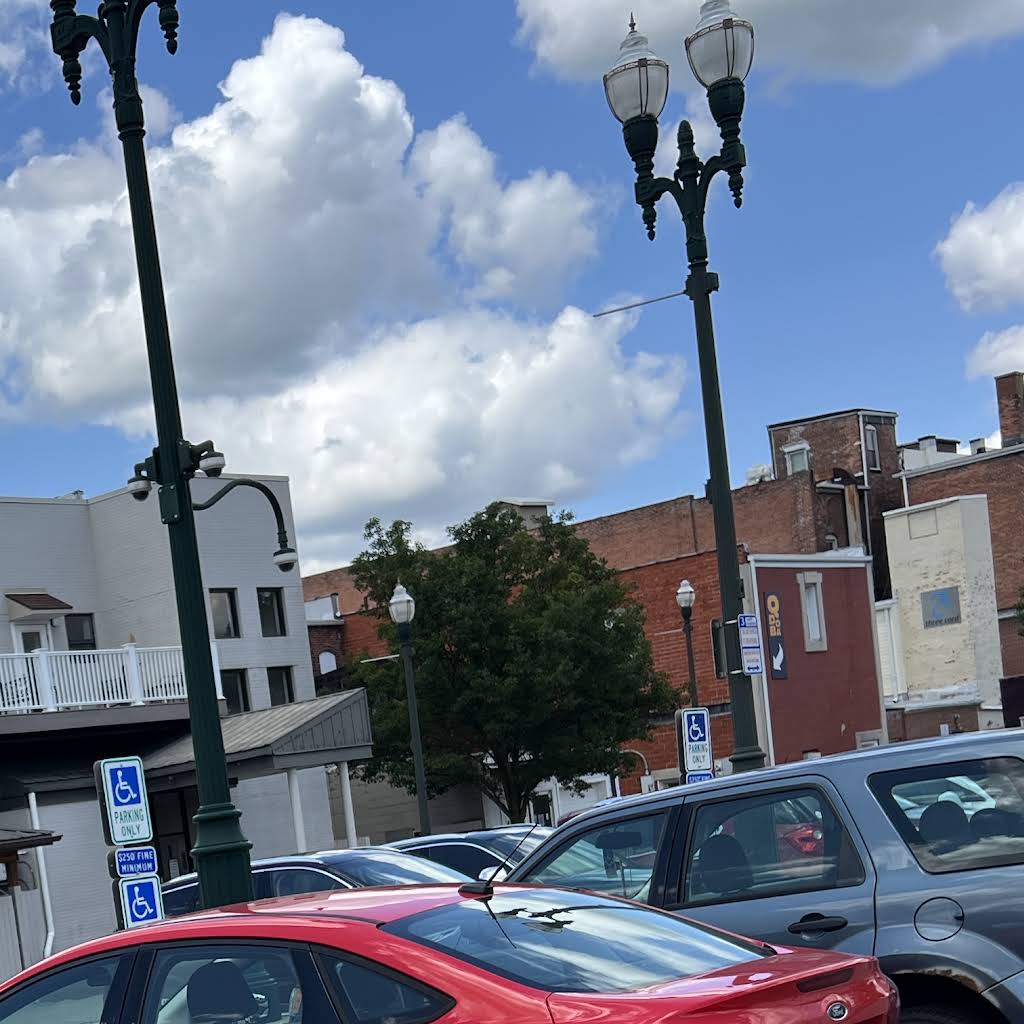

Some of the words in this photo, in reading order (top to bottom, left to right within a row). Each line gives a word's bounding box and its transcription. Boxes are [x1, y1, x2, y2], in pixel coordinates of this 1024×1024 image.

[688, 741, 709, 753] PARKING
[692, 754, 706, 765] ONLY
[114, 808, 144, 824] PARKING
[121, 824, 142, 837] ONLY
[118, 851, 135, 863] $250
[137, 850, 154, 861] FINE
[120, 861, 153, 874] MINIMUM
